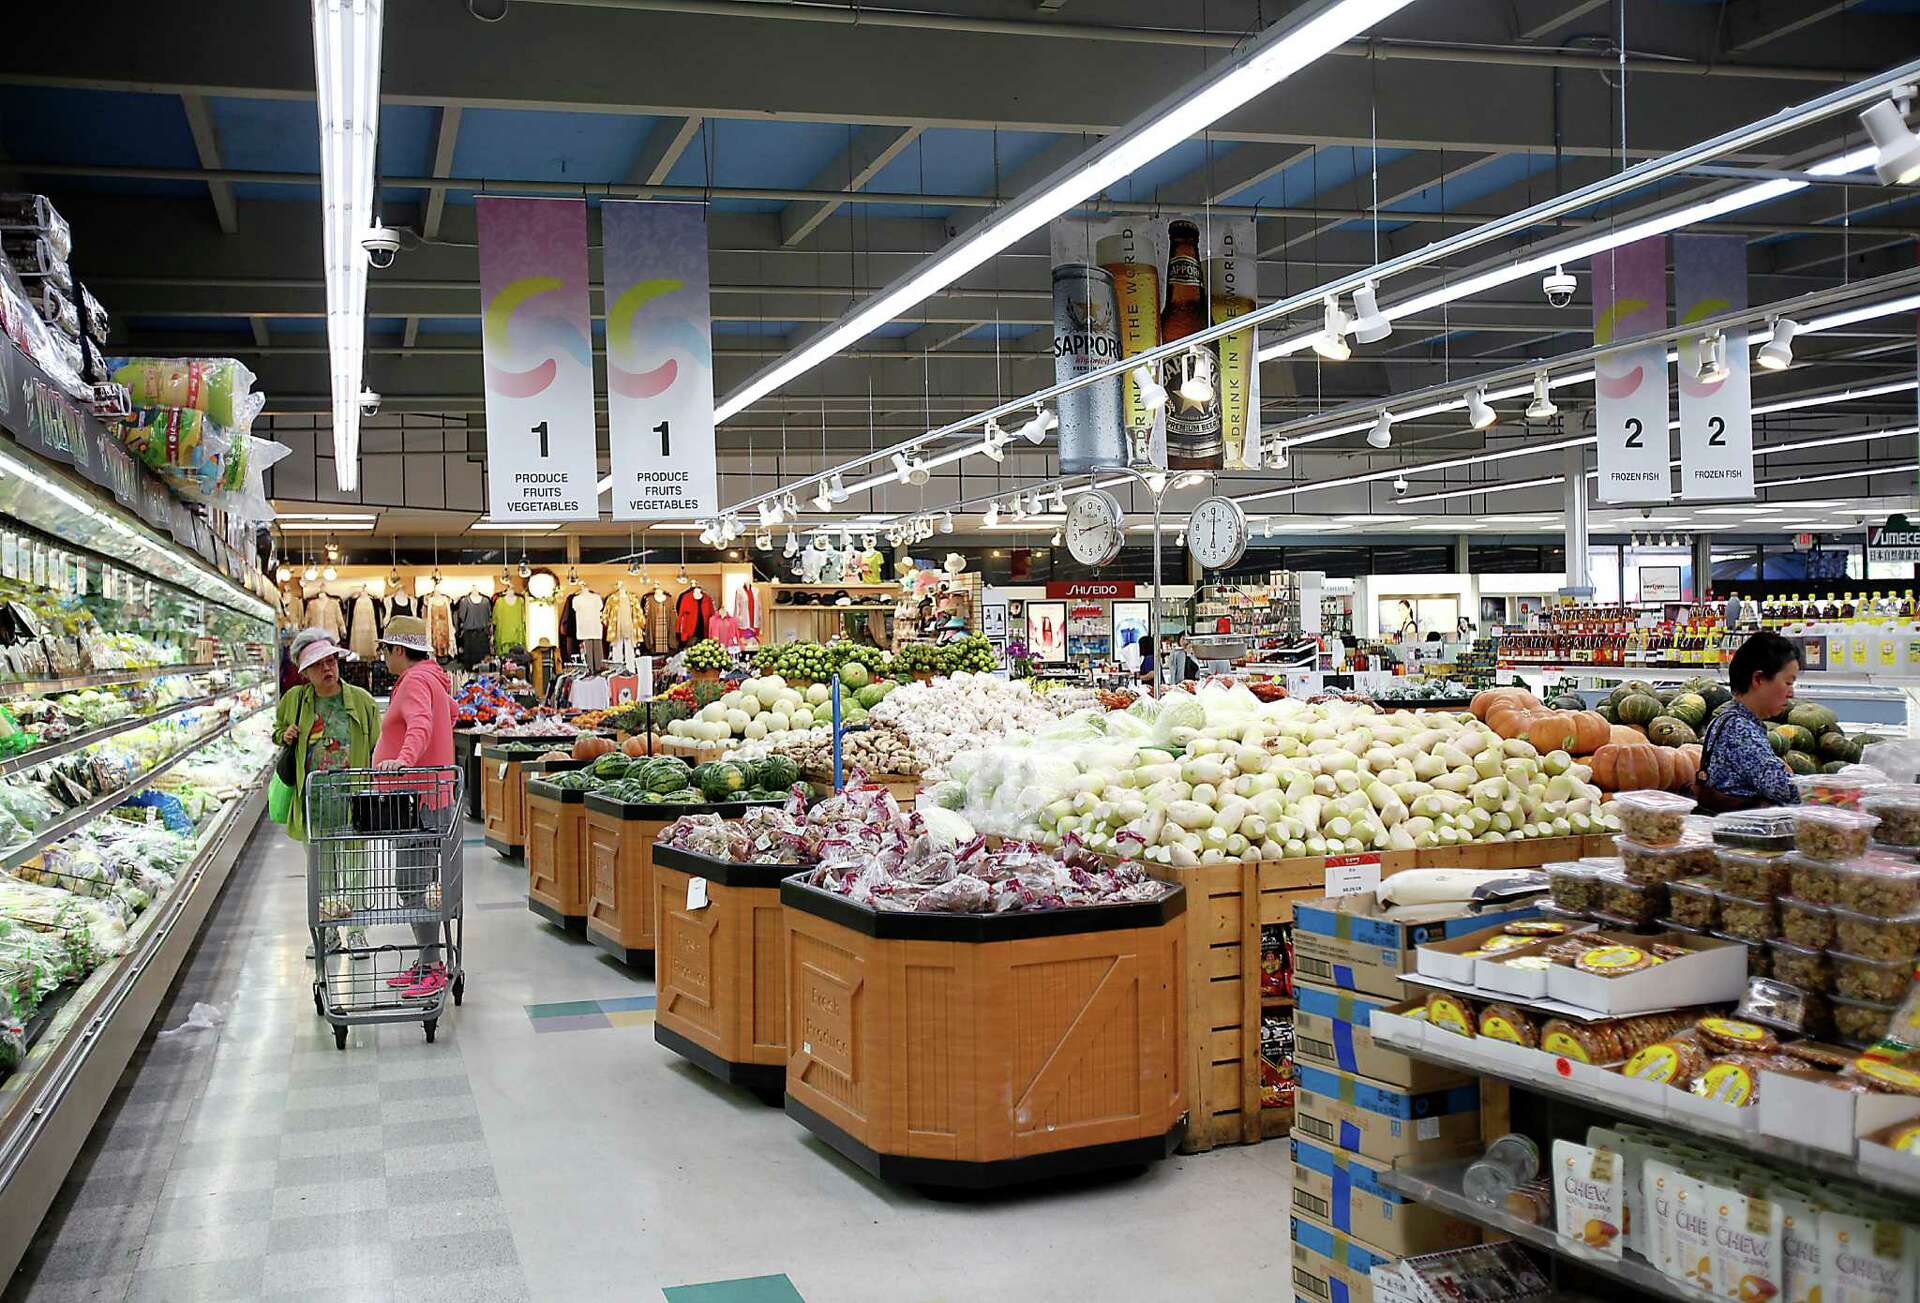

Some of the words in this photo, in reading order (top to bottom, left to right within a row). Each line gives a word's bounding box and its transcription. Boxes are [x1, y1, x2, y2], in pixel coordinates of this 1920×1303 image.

[1122, 228, 1137, 295] WORLD
[1223, 235, 1236, 301] WORLD
[1128, 304, 1141, 341] THE
[1226, 306, 1238, 342] TE
[1228, 352, 1239, 369] IN
[1229, 379, 1240, 437] DRINK
[531, 421, 548, 458] 1
[652, 421, 670, 457] 1
[1624, 418, 1643, 448] 2
[1707, 416, 1726, 446] 2
[515, 473, 569, 483] PRODUCE
[637, 471, 689, 482] PRODUCE
[1610, 472, 1641, 481] FROZEN
[1642, 472, 1660, 480] FISH
[1694, 470, 1725, 479] FROZEN
[1725, 469, 1742, 478] FISH
[523, 487, 562, 498] FRUITS
[645, 486, 682, 496] FRUITS
[507, 501, 579, 512] VEGETABLES
[629, 499, 699, 510] VEGETABLES
[1066, 585, 1118, 596] SHISEIDO
